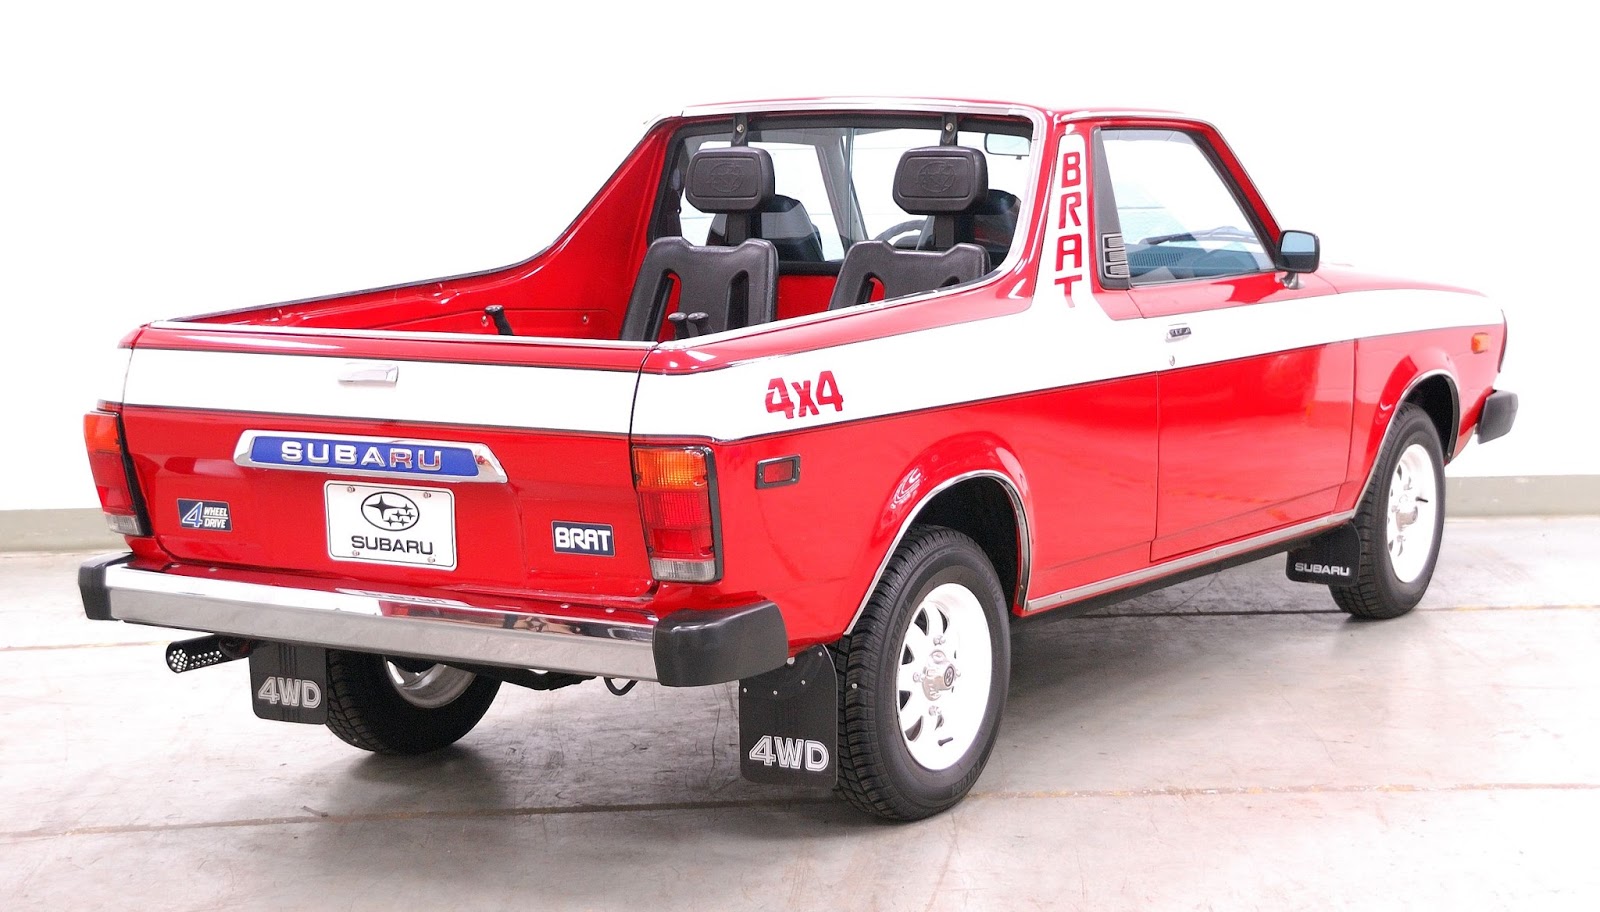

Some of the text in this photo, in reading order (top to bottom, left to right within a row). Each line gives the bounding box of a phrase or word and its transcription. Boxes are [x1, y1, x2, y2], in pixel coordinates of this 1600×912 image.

[1054, 151, 1083, 308] BRAT
[765, 370, 844, 420] 4x4
[281, 440, 442, 471] SUBARU
[181, 501, 203, 528] 4
[204, 506, 228, 517] WHEEL
[204, 518, 227, 529] DRIVE
[351, 535, 434, 556] SUBARU
[554, 526, 611, 552] BRAT
[1294, 561, 1350, 577] SUBARU
[258, 676, 322, 709] 4WD
[748, 735, 830, 772] 4WD
